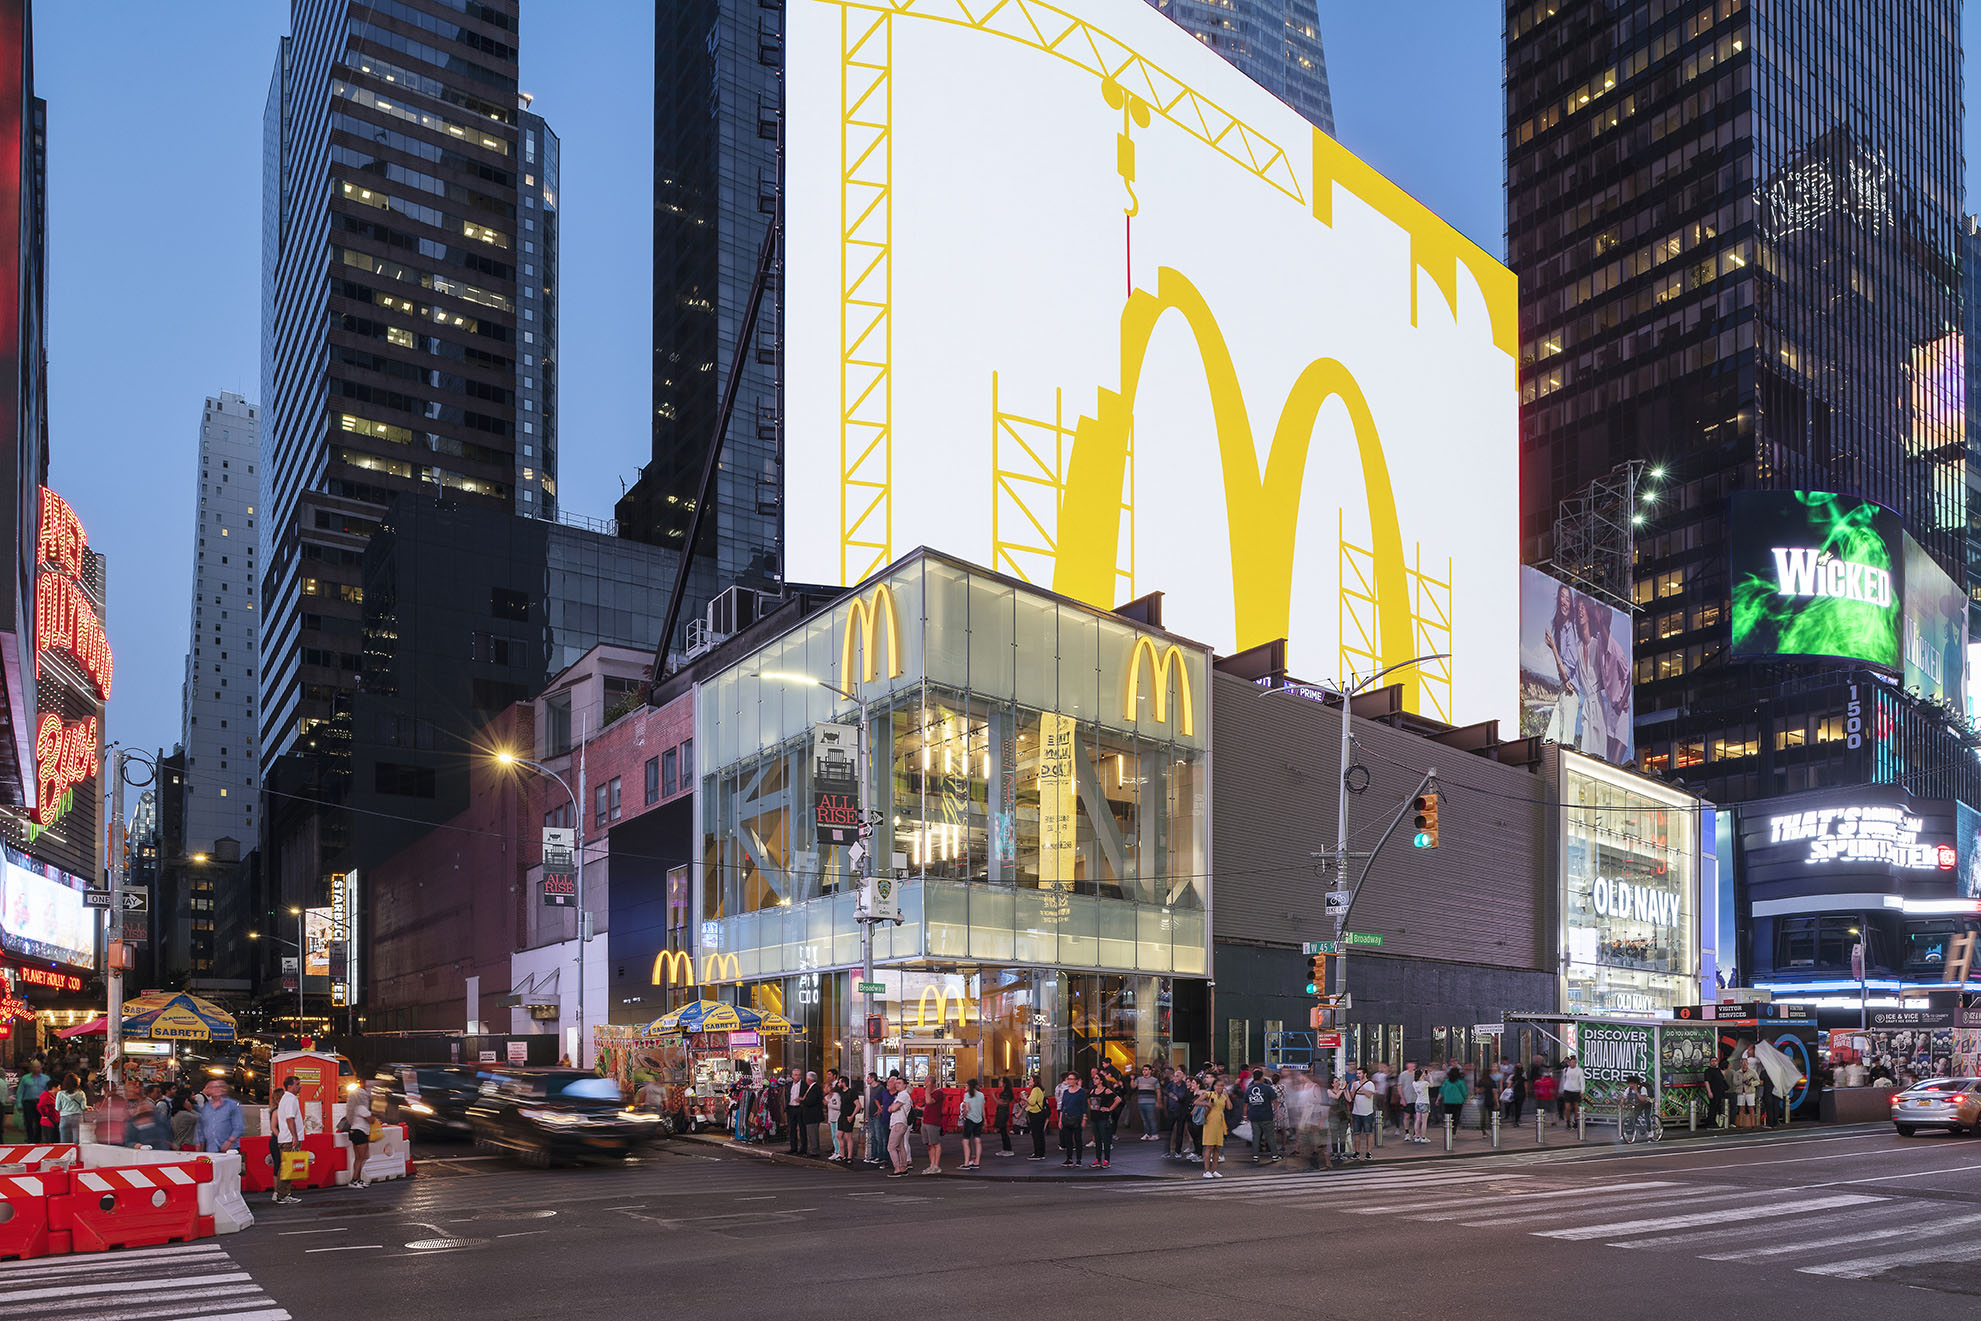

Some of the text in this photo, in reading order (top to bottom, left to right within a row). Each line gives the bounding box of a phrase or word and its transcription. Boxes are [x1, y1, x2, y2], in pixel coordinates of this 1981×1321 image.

[37, 572, 113, 701] OLLYWOOD
[1299, 687, 1323, 702] PRIME
[1847, 685, 1862, 749] 1500
[819, 794, 855, 810] ALL
[816, 808, 858, 824] RISE
[546, 873, 572, 884] ALL
[544, 882, 575, 893] RISE
[92, 895, 110, 904] ONE
[1593, 876, 1681, 928] OLD NAVY
[334, 880, 343, 941] STARBUC
[1354, 934, 1382, 946] Broadway
[1311, 943, 1318, 952] W
[1320, 943, 1328, 953] 45
[23, 967, 81, 991] PLANET HOLLYOOD
[859, 983, 885, 993] Broadway
[1616, 993, 1653, 1010] OLD NAVY
[154, 1027, 206, 1037] SABRETT
[1584, 1029, 1648, 1042] DISCOVER
[1584, 1040, 1648, 1071] BROADWAY'S
[1583, 1068, 1647, 1083] SECRETS
